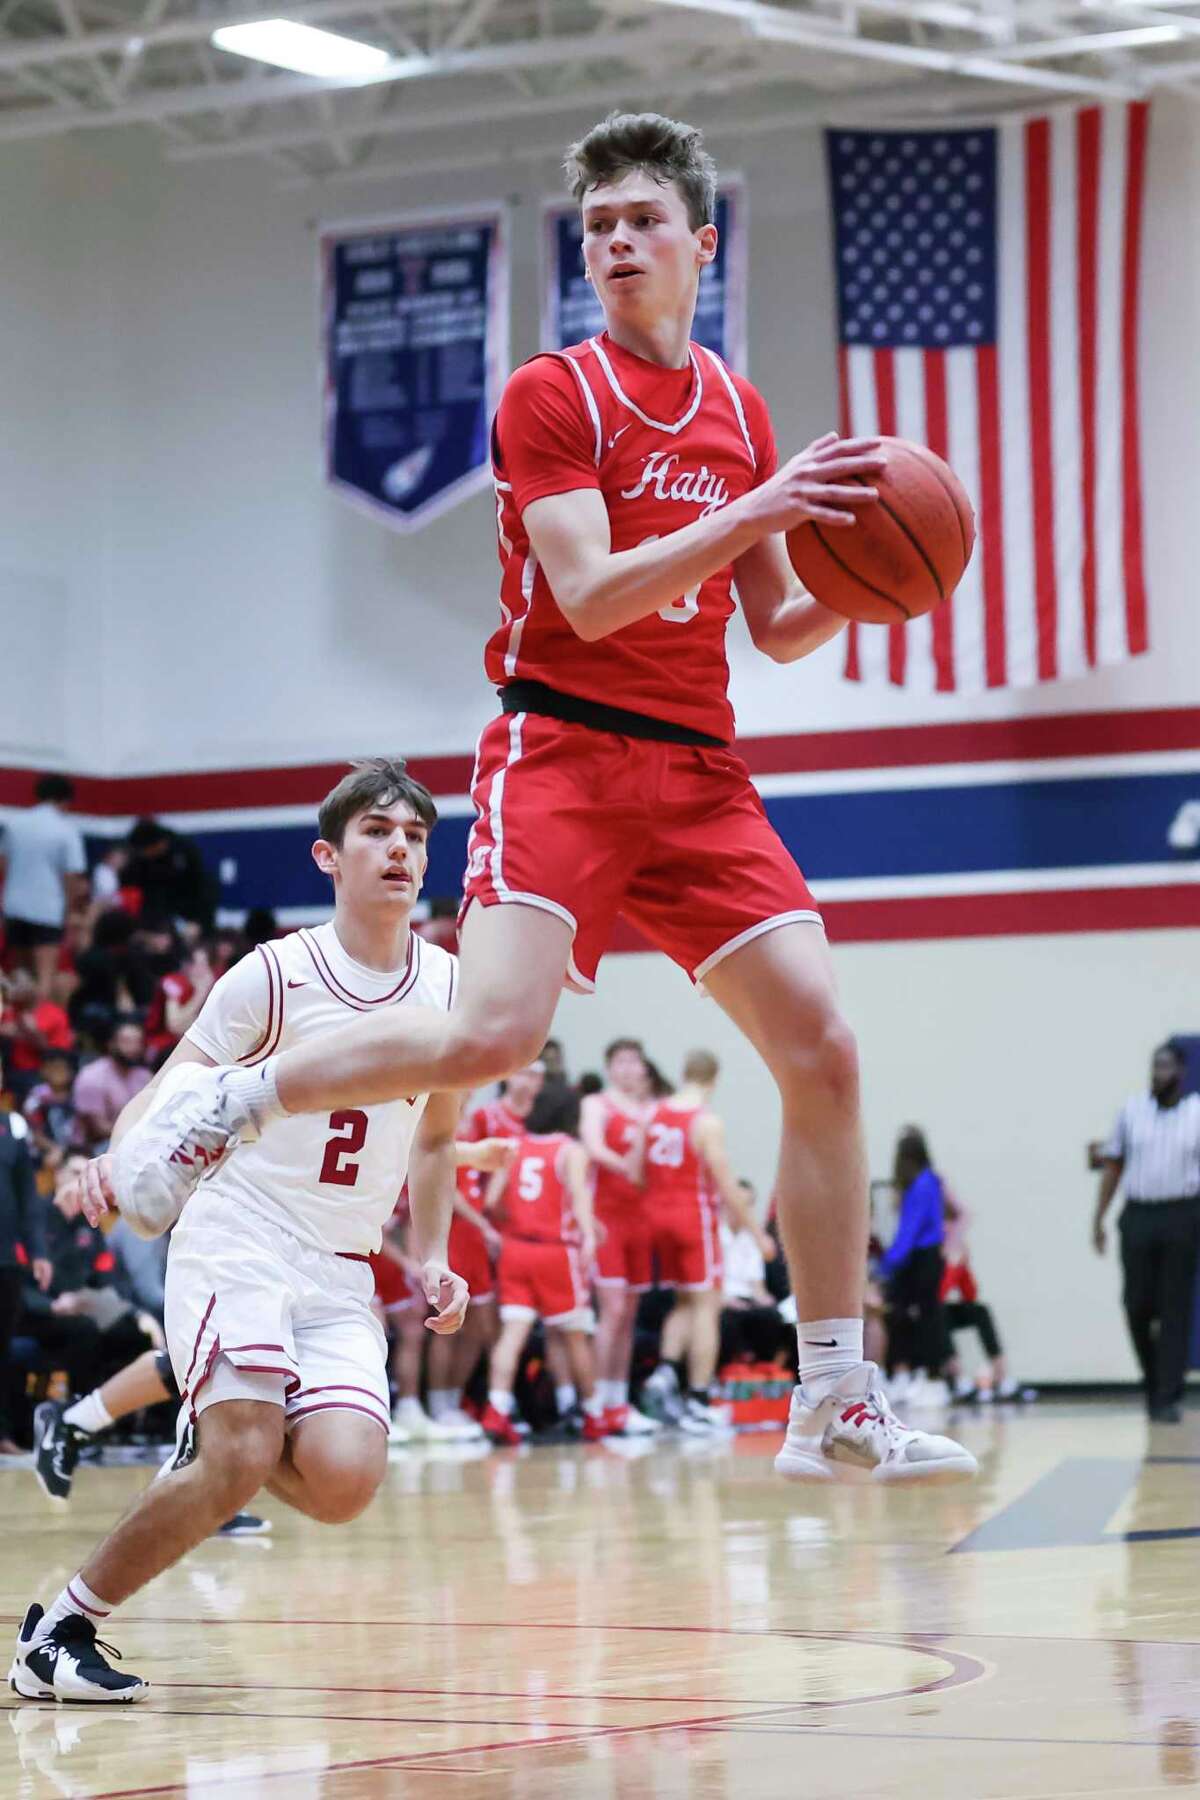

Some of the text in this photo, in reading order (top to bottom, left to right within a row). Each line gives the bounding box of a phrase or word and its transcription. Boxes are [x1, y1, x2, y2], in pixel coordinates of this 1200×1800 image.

[621, 452, 728, 520] Katy
[319, 1109, 368, 1186] 2
[519, 1157, 545, 1201] 5
